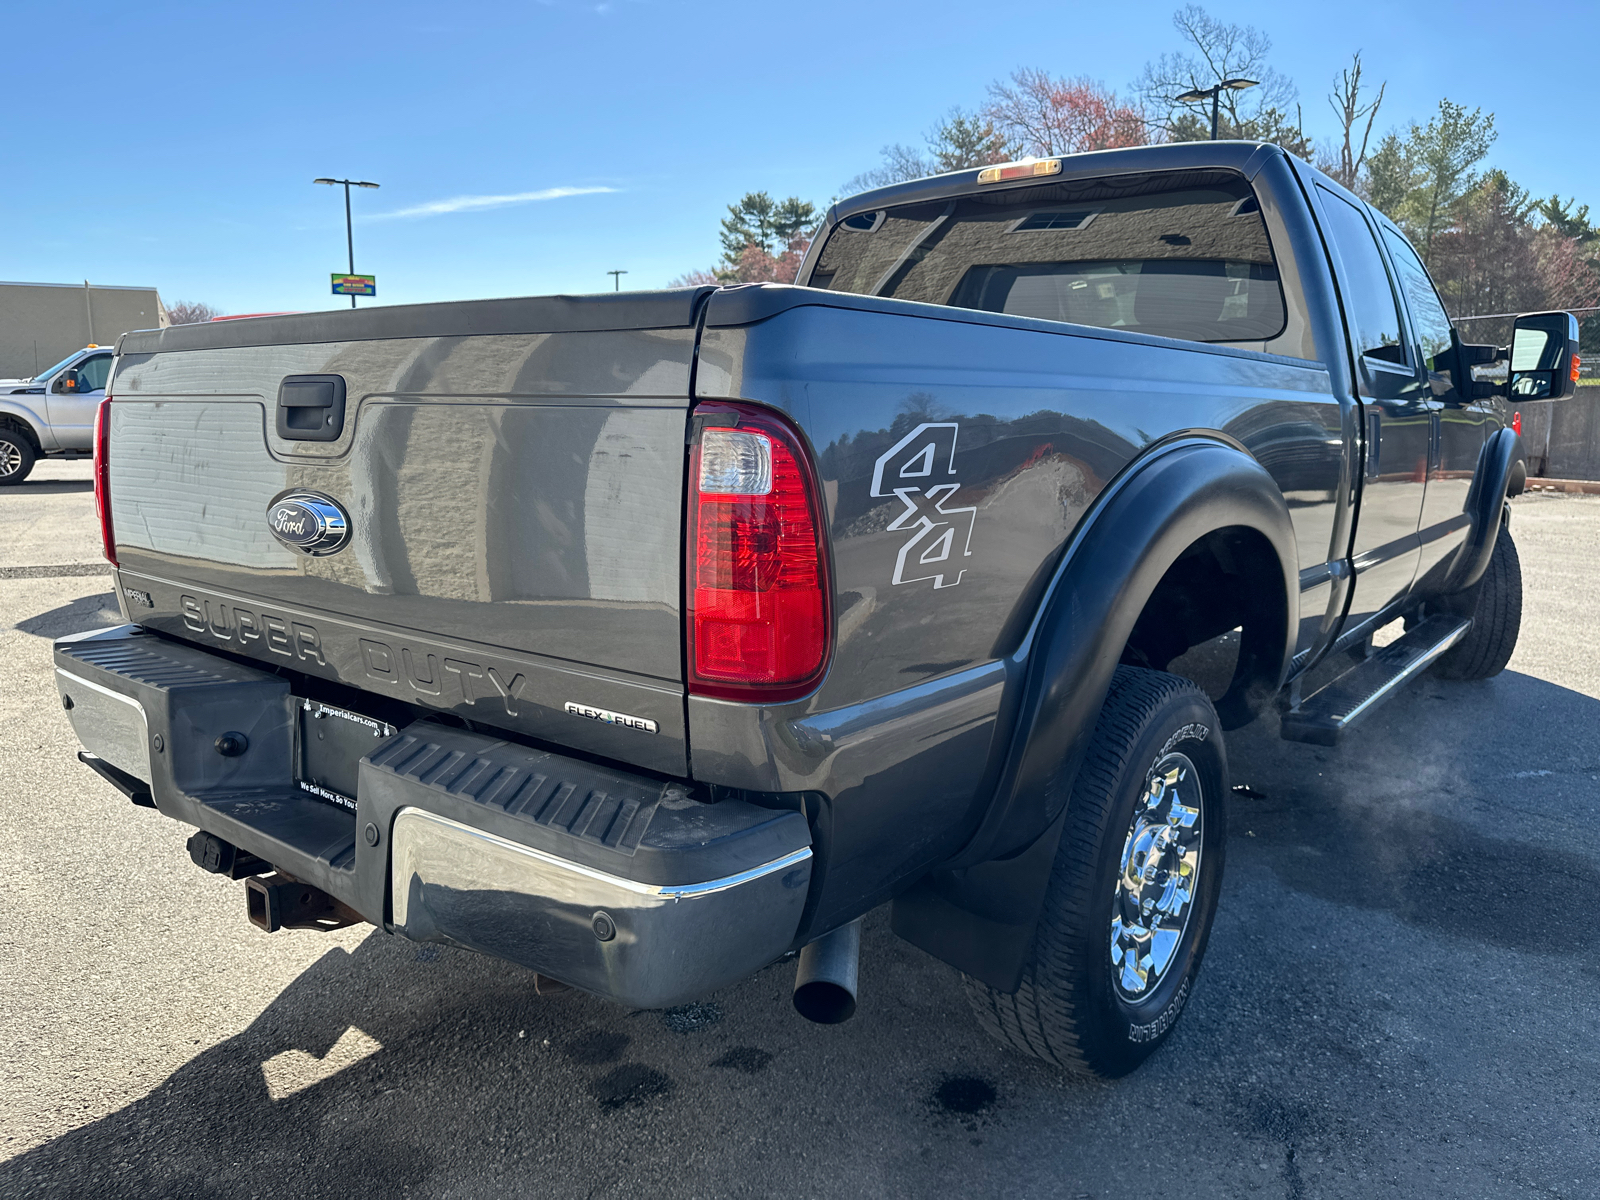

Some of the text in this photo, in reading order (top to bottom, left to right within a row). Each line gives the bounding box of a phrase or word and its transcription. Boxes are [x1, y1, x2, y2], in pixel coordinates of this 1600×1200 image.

[274, 508, 305, 535] Ford
[179, 594, 526, 717] SUPER DUTY
[319, 704, 379, 730] Imperialcars.com
[568, 705, 655, 733] FLEX FUEL
[300, 781, 309, 792] We
[309, 785, 320, 795] Sell
[320, 789, 335, 802] More,
[335, 795, 343, 805] So
[344, 798, 355, 809] You
[1128, 976, 1191, 1043] MICHELIN
